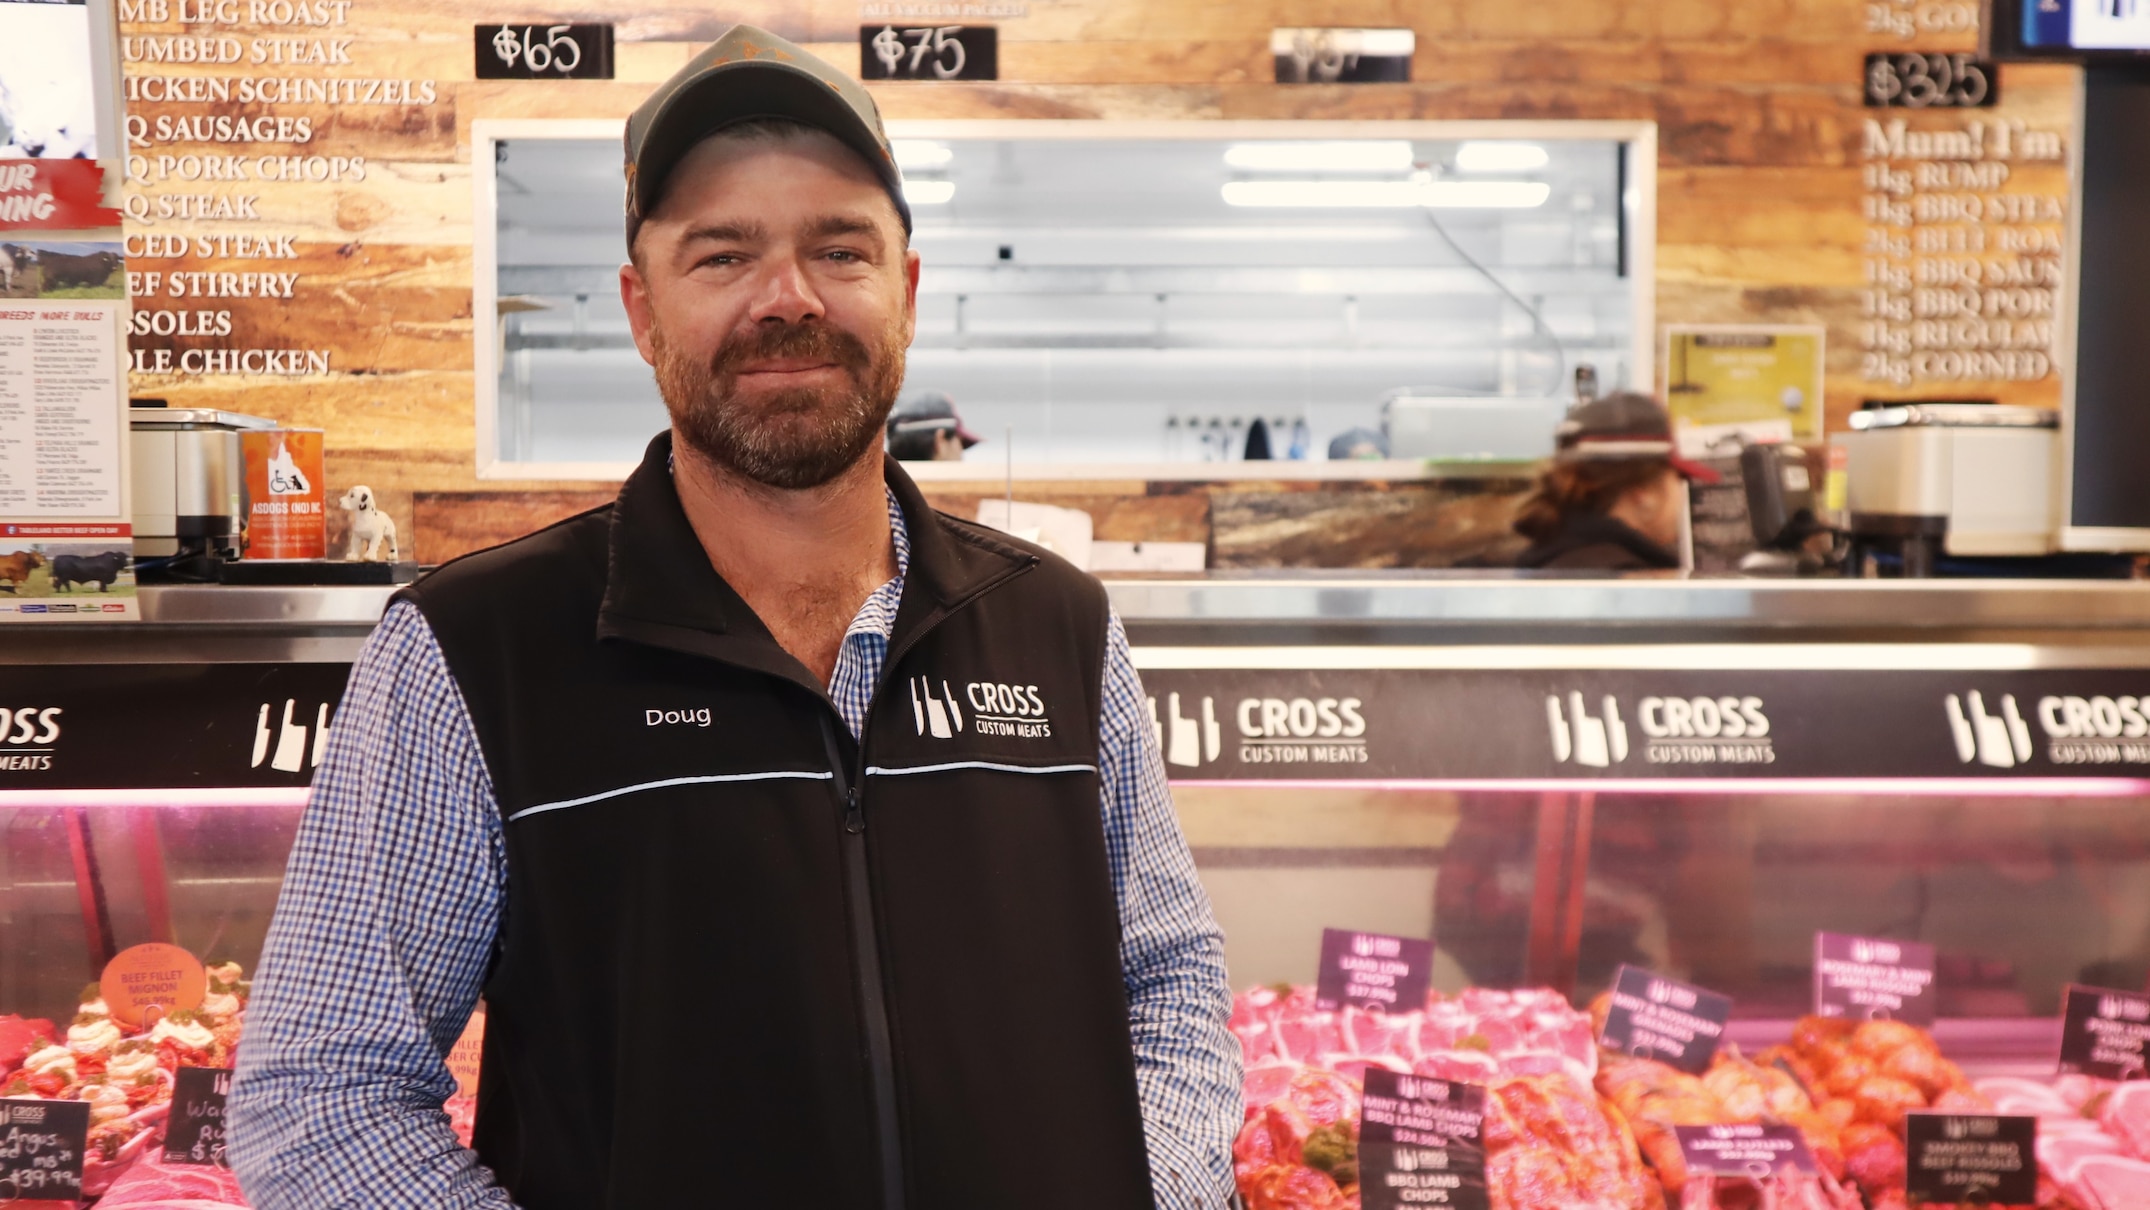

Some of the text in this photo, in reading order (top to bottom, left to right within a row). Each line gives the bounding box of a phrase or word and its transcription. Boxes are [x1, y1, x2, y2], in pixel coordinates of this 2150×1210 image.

[119, 0, 351, 26] MB LEG ROAST
[251, 38, 352, 64] STEAK
[492, 24, 581, 72] $65
[872, 25, 966, 80] $75
[239, 77, 436, 104] SCHNITZELS
[155, 115, 312, 142] SAUSAGES
[1863, 117, 2062, 160] Mum! I'm
[158, 155, 250, 181] PORK
[256, 156, 366, 182] CHOPS
[1863, 162, 2010, 197] 1kg RUMP
[124, 194, 261, 225] Q STEAK
[1863, 193, 1914, 228] 1kg
[1915, 193, 1985, 223] BBQ
[124, 233, 299, 259] CED STEAK
[127, 271, 299, 298] EF STIRFRY
[1864, 257, 1913, 291] 1kg
[1914, 256, 1984, 288] BBQ
[1864, 288, 1913, 322] 1kg
[1914, 288, 1984, 319] BBQ
[1864, 319, 1913, 354] 1kg
[180, 349, 330, 376] CHICKEN
[1864, 350, 1913, 387] 2kg
[252, 502, 289, 514] ASDOGS
[967, 682, 1045, 716] CROSS
[645, 708, 711, 727] Doug
[976, 720, 1051, 738] CUSTOM MEATS
[1237, 698, 1366, 737] CROSS
[1638, 696, 1770, 738] CROSS
[1239, 746, 1369, 763] CUSTOM MEATS
[1646, 746, 1776, 763] CUSTOM MEATS
[2050, 743, 2121, 764] CUSTOM
[121, 970, 183, 983] BEEF FILLET
[1340, 956, 1378, 972] LAMB
[129, 982, 178, 994] MIGNON
[1350, 971, 1395, 987] CHOPS
[12, 1106, 46, 1118] CROSS
[1363, 1095, 1398, 1112] MINT
[1398, 1101, 1411, 1114] &
[1365, 1109, 1478, 1139] BBQ LAMB CHOPS
[1385, 1173, 1461, 1189] BBQ LAMB
[1400, 1188, 1449, 1203] CHOPS
